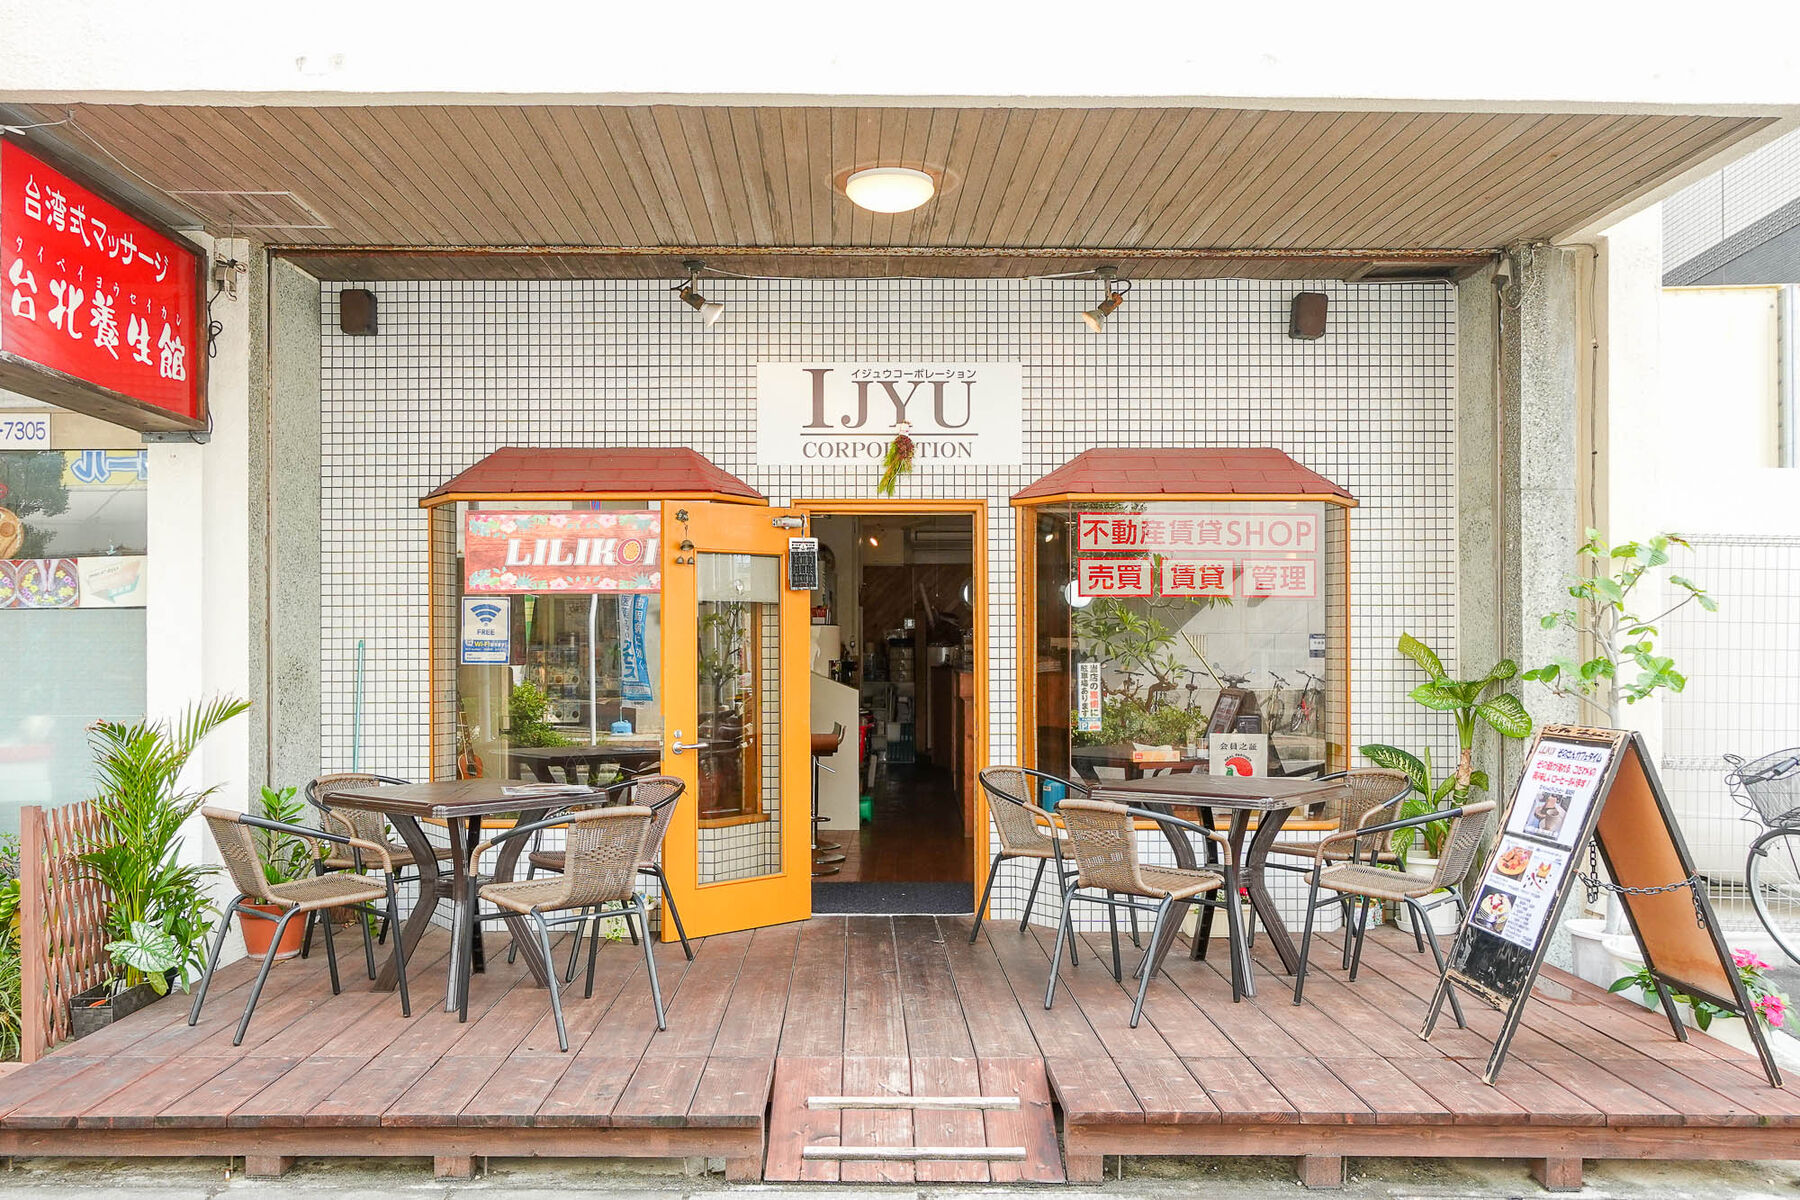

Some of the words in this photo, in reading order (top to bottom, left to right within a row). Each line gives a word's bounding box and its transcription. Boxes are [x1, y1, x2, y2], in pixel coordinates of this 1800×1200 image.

[25, 174, 169, 282] 台湾式マッサージ
[8, 258, 186, 381] 台北養生館
[850, 368, 977, 379] イジュウコーポレーション
[802, 368, 977, 429] IJYU
[802, 441, 972, 458] CORPOTION
[1083, 519, 1312, 547] 不動産賃貸SHOP
[504, 537, 660, 567] LILIKOI
[1088, 564, 1142, 590] 売買
[1170, 564, 1225, 590] 賃貸
[1252, 564, 1306, 591] 管理
